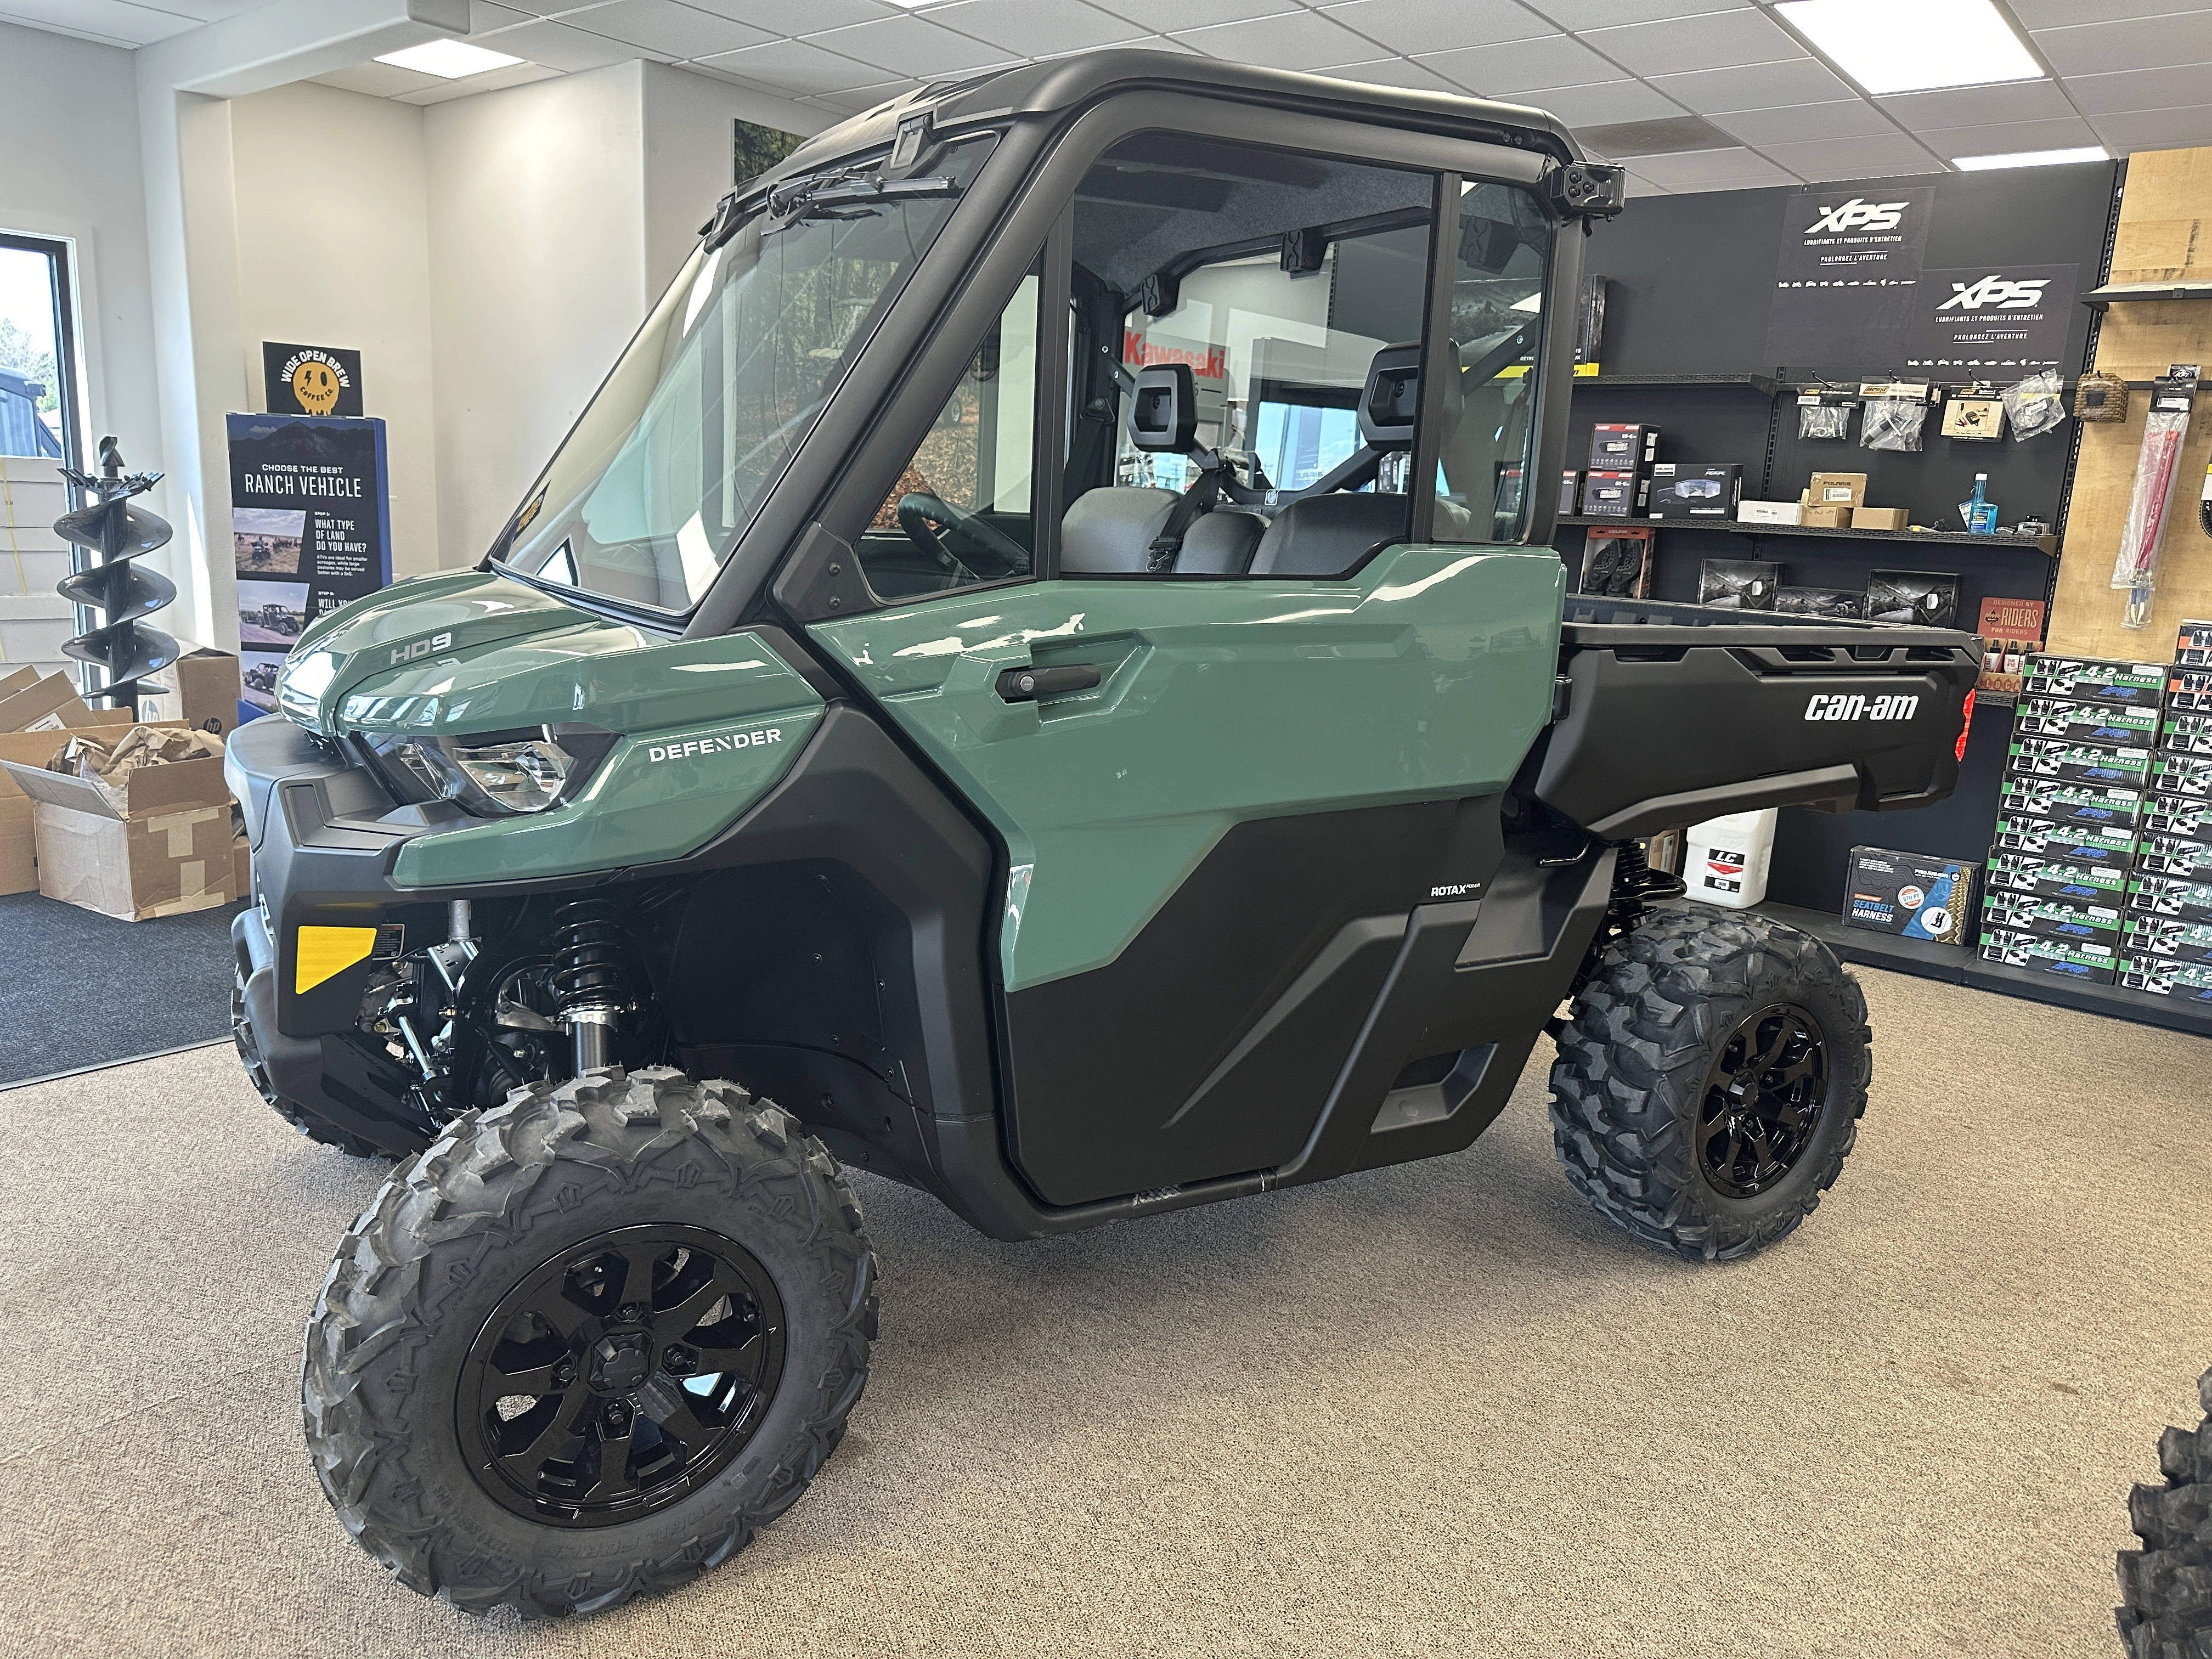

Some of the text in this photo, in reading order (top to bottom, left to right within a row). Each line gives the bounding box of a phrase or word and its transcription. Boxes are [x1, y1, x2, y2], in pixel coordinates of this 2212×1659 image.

[1804, 199, 1910, 233] XPS
[1935, 275, 2051, 309] XPS
[1125, 331, 1224, 379] Kawasaki
[281, 350, 351, 387] WIDE OPEN BREW
[300, 386, 325, 401] COFFEE
[262, 464, 298, 472] CHOOSE
[245, 473, 362, 498] RANCH VEHICLE
[315, 518, 354, 530] WHAT TYPE
[315, 530, 345, 540] OF LAND
[317, 540, 367, 552] DO YOU HAVE?
[318, 598, 335, 609] WILL
[2001, 607, 2039, 628] RIDERS
[390, 632, 452, 664] HD9
[2085, 665, 2158, 684] 4.2 Harness
[1804, 695, 1918, 720] can-am
[2079, 706, 2151, 725] 4.2 Harness
[206, 717, 220, 733] hp
[649, 728, 782, 762] DEFENDER
[2071, 746, 2142, 766] 4.2 Harness
[2062, 786, 2132, 807] 4.2 Harness
[2057, 825, 2128, 847] 4.2 Harness
[1716, 851, 1737, 863] LC
[2046, 864, 2117, 885] 4.2 Harness
[1431, 884, 1466, 896] ROTAX
[2059, 884, 2097, 896] PRP
[1852, 908, 1893, 922] HARNESS
[1853, 899, 1895, 913] SEATBELT
[2043, 901, 2112, 924] 4.2 Harness
[2056, 923, 2093, 935] PRP
[2039, 940, 2108, 963] 4.2 Harness
[2051, 961, 2089, 973] PRP
